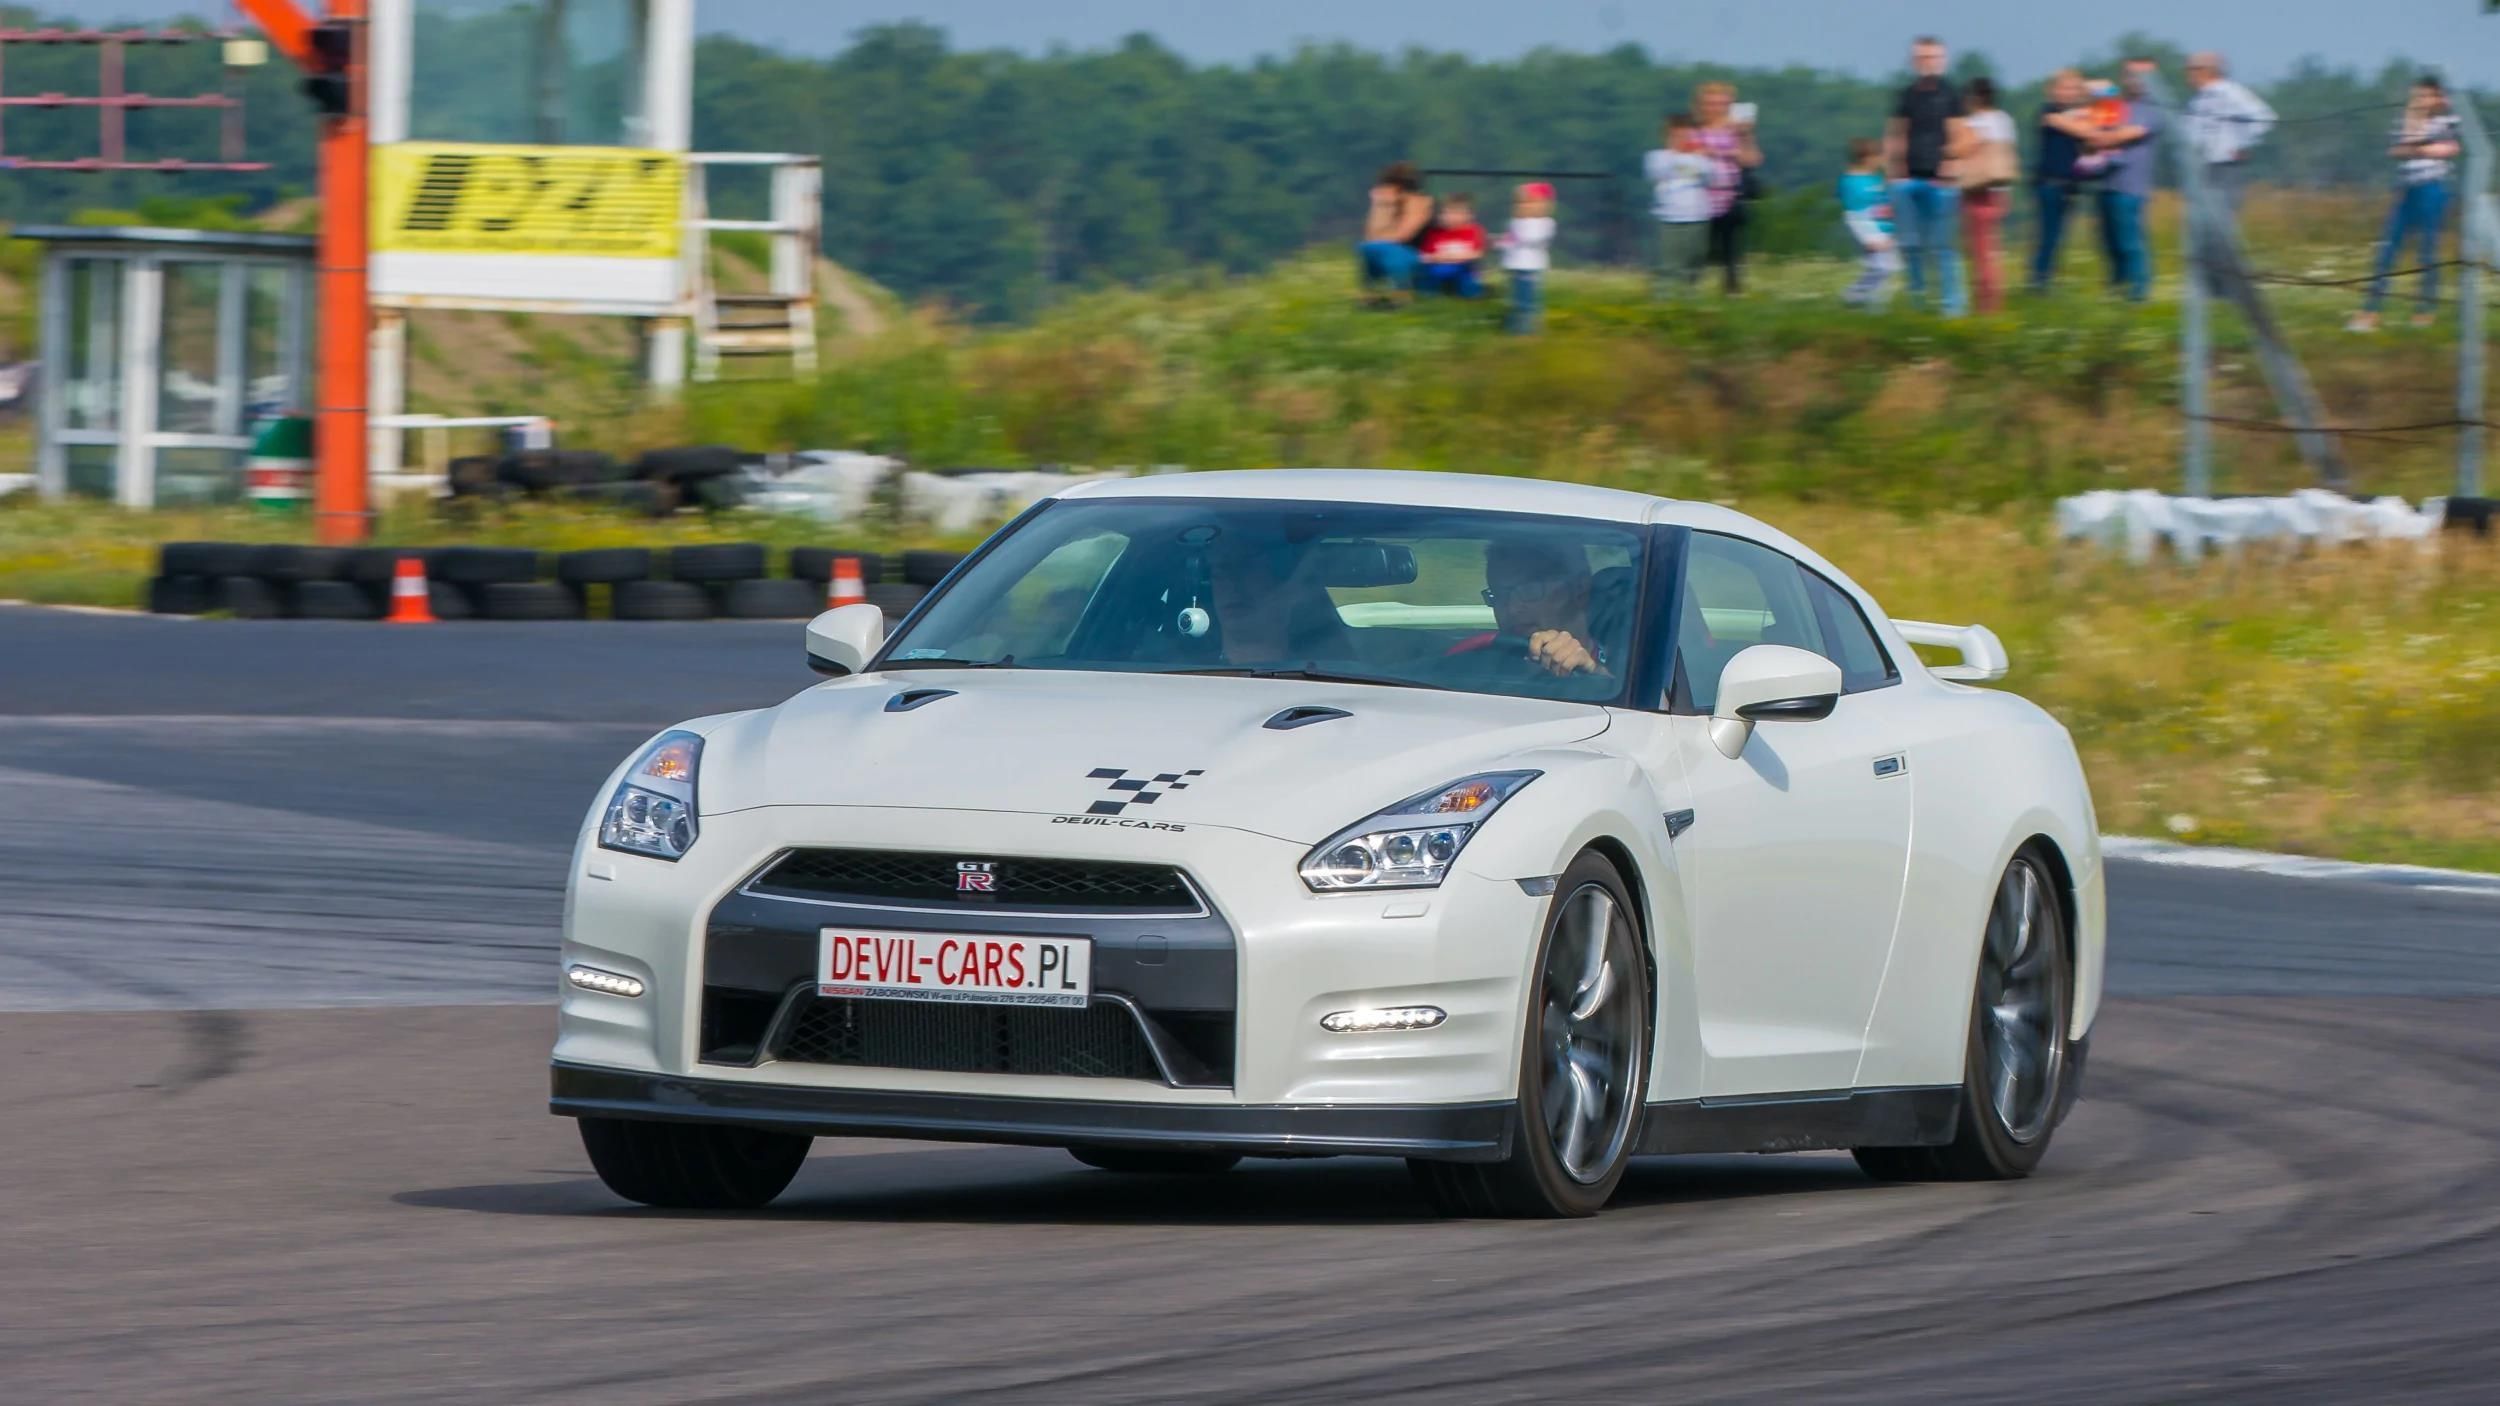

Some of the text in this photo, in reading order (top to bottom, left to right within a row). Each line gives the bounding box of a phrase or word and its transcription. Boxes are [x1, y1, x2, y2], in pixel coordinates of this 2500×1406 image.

[1051, 816, 1187, 832] DEVIL-CARS
[956, 861, 998, 871] GT
[956, 872, 998, 891] R
[831, 936, 1077, 989] DEVIL-CARS.PL
[821, 986, 864, 995] NISSAN
[864, 988, 929, 999] ZABOROWSKI
